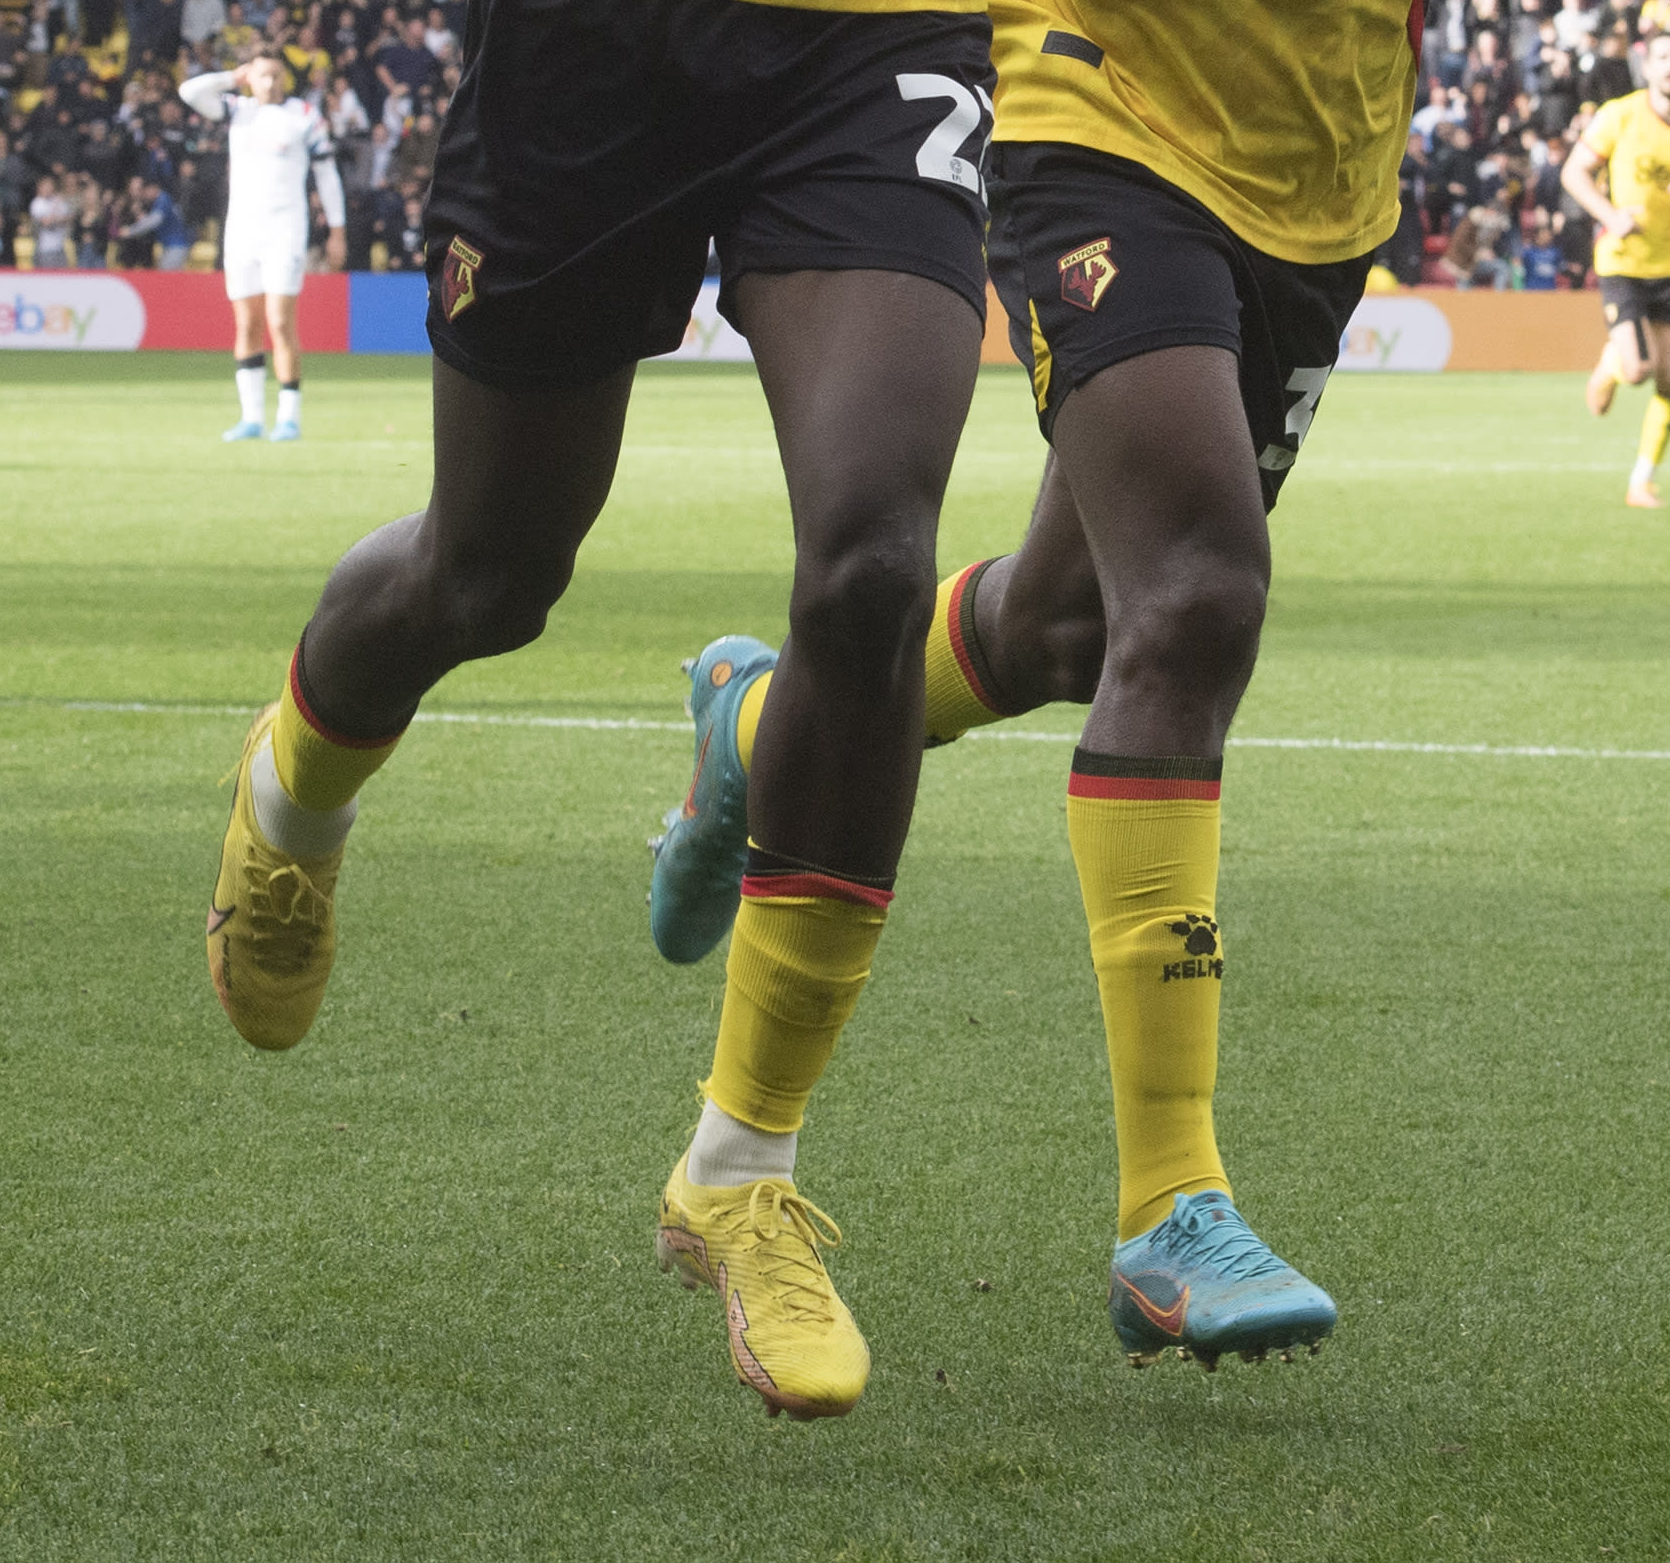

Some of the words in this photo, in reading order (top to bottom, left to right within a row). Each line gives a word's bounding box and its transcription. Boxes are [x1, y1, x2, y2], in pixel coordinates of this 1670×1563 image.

[1063, 243, 1106, 266] WATFORD
[1339, 324, 1404, 366] ay
[1162, 958, 1223, 983] KELM
